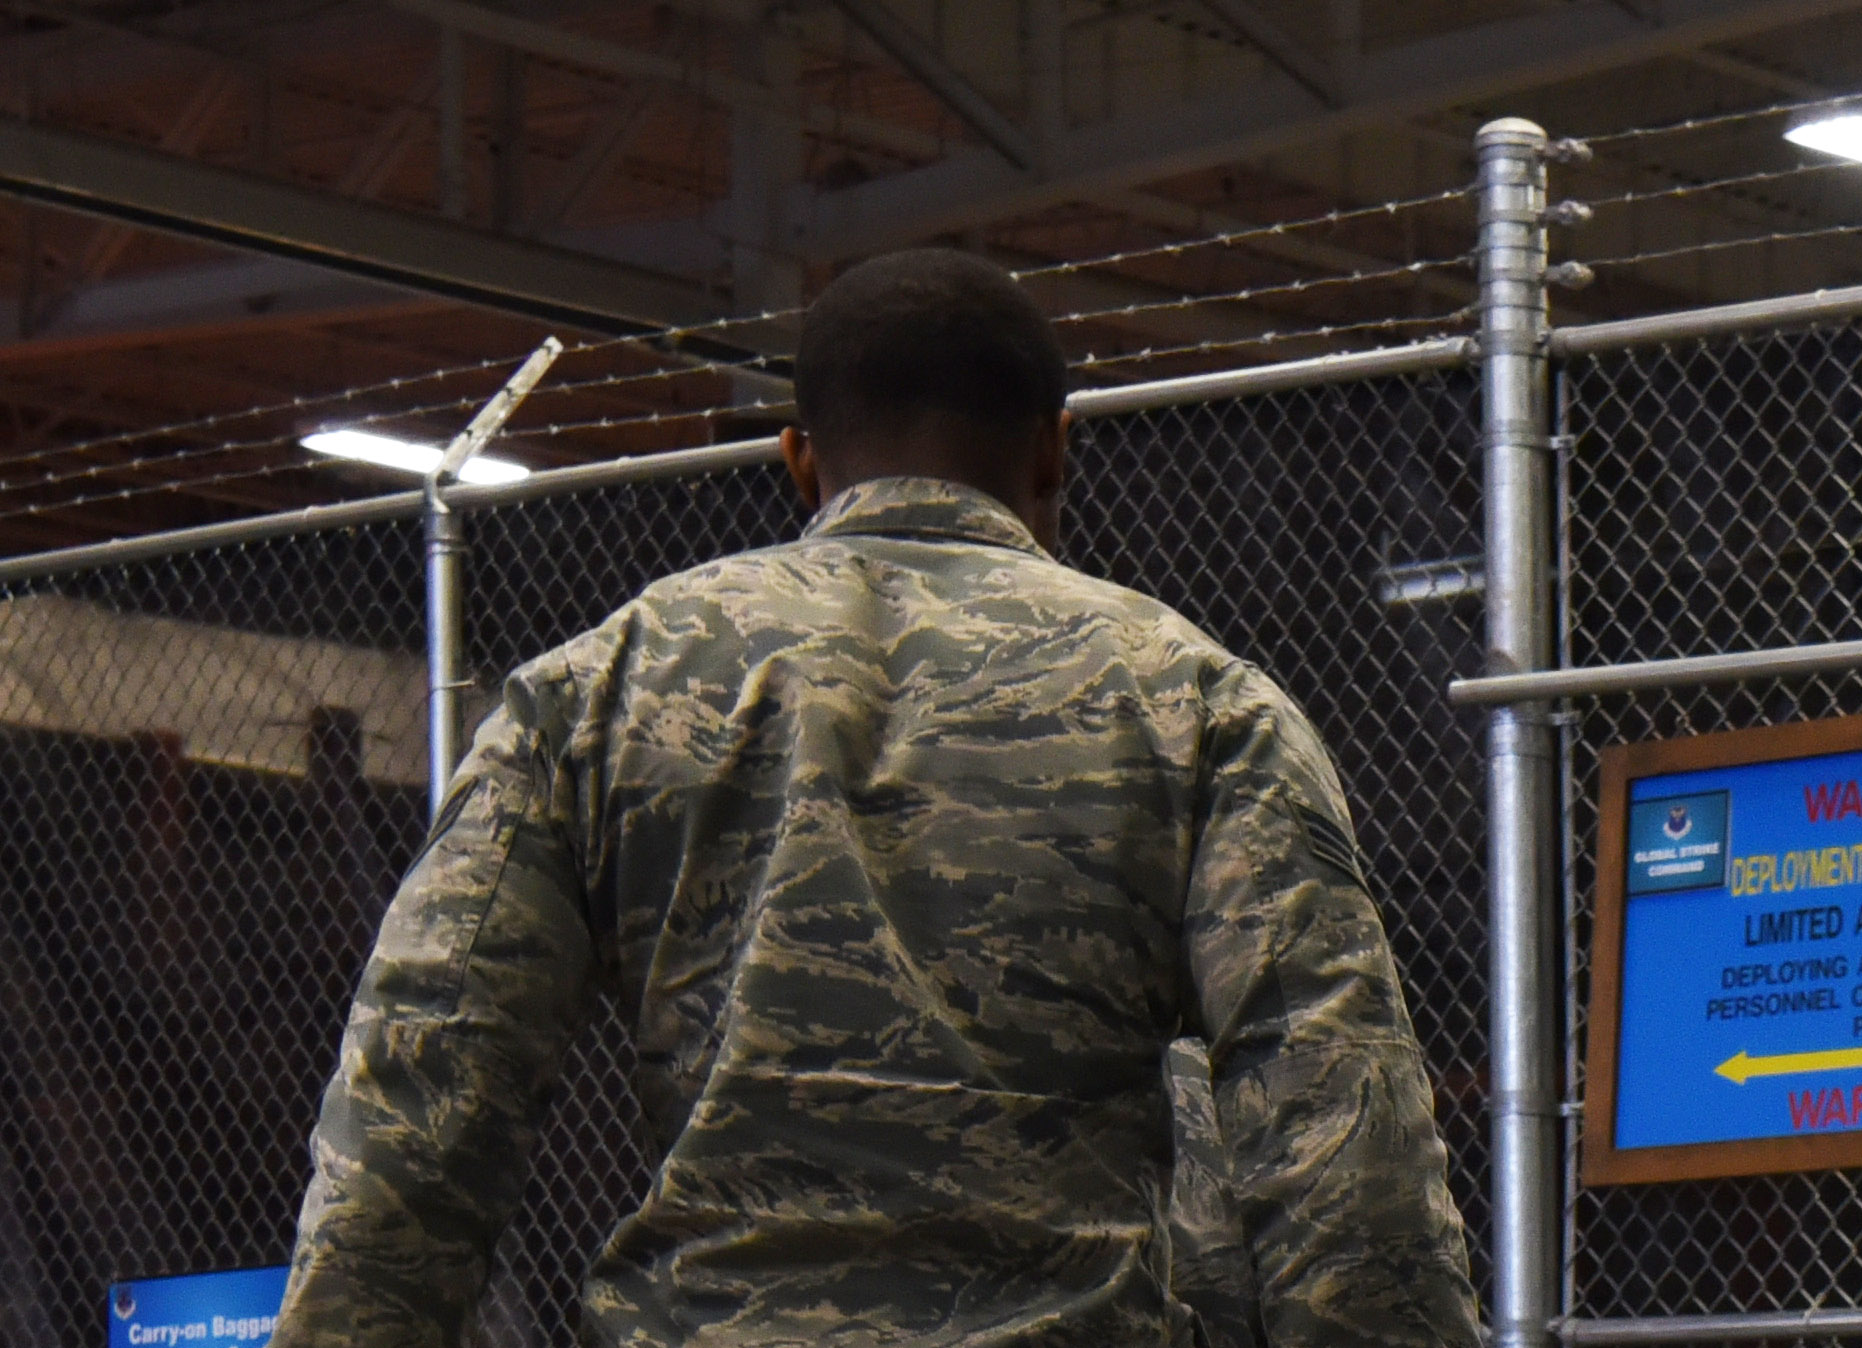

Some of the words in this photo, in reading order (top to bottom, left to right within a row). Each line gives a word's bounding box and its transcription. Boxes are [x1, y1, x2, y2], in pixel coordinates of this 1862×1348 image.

[1744, 905, 1843, 947] LIMITED
[1721, 955, 1848, 990] DEPLOYING
[1705, 988, 1841, 1022] PERSONNEL
[128, 1322, 207, 1348] Carry-on
